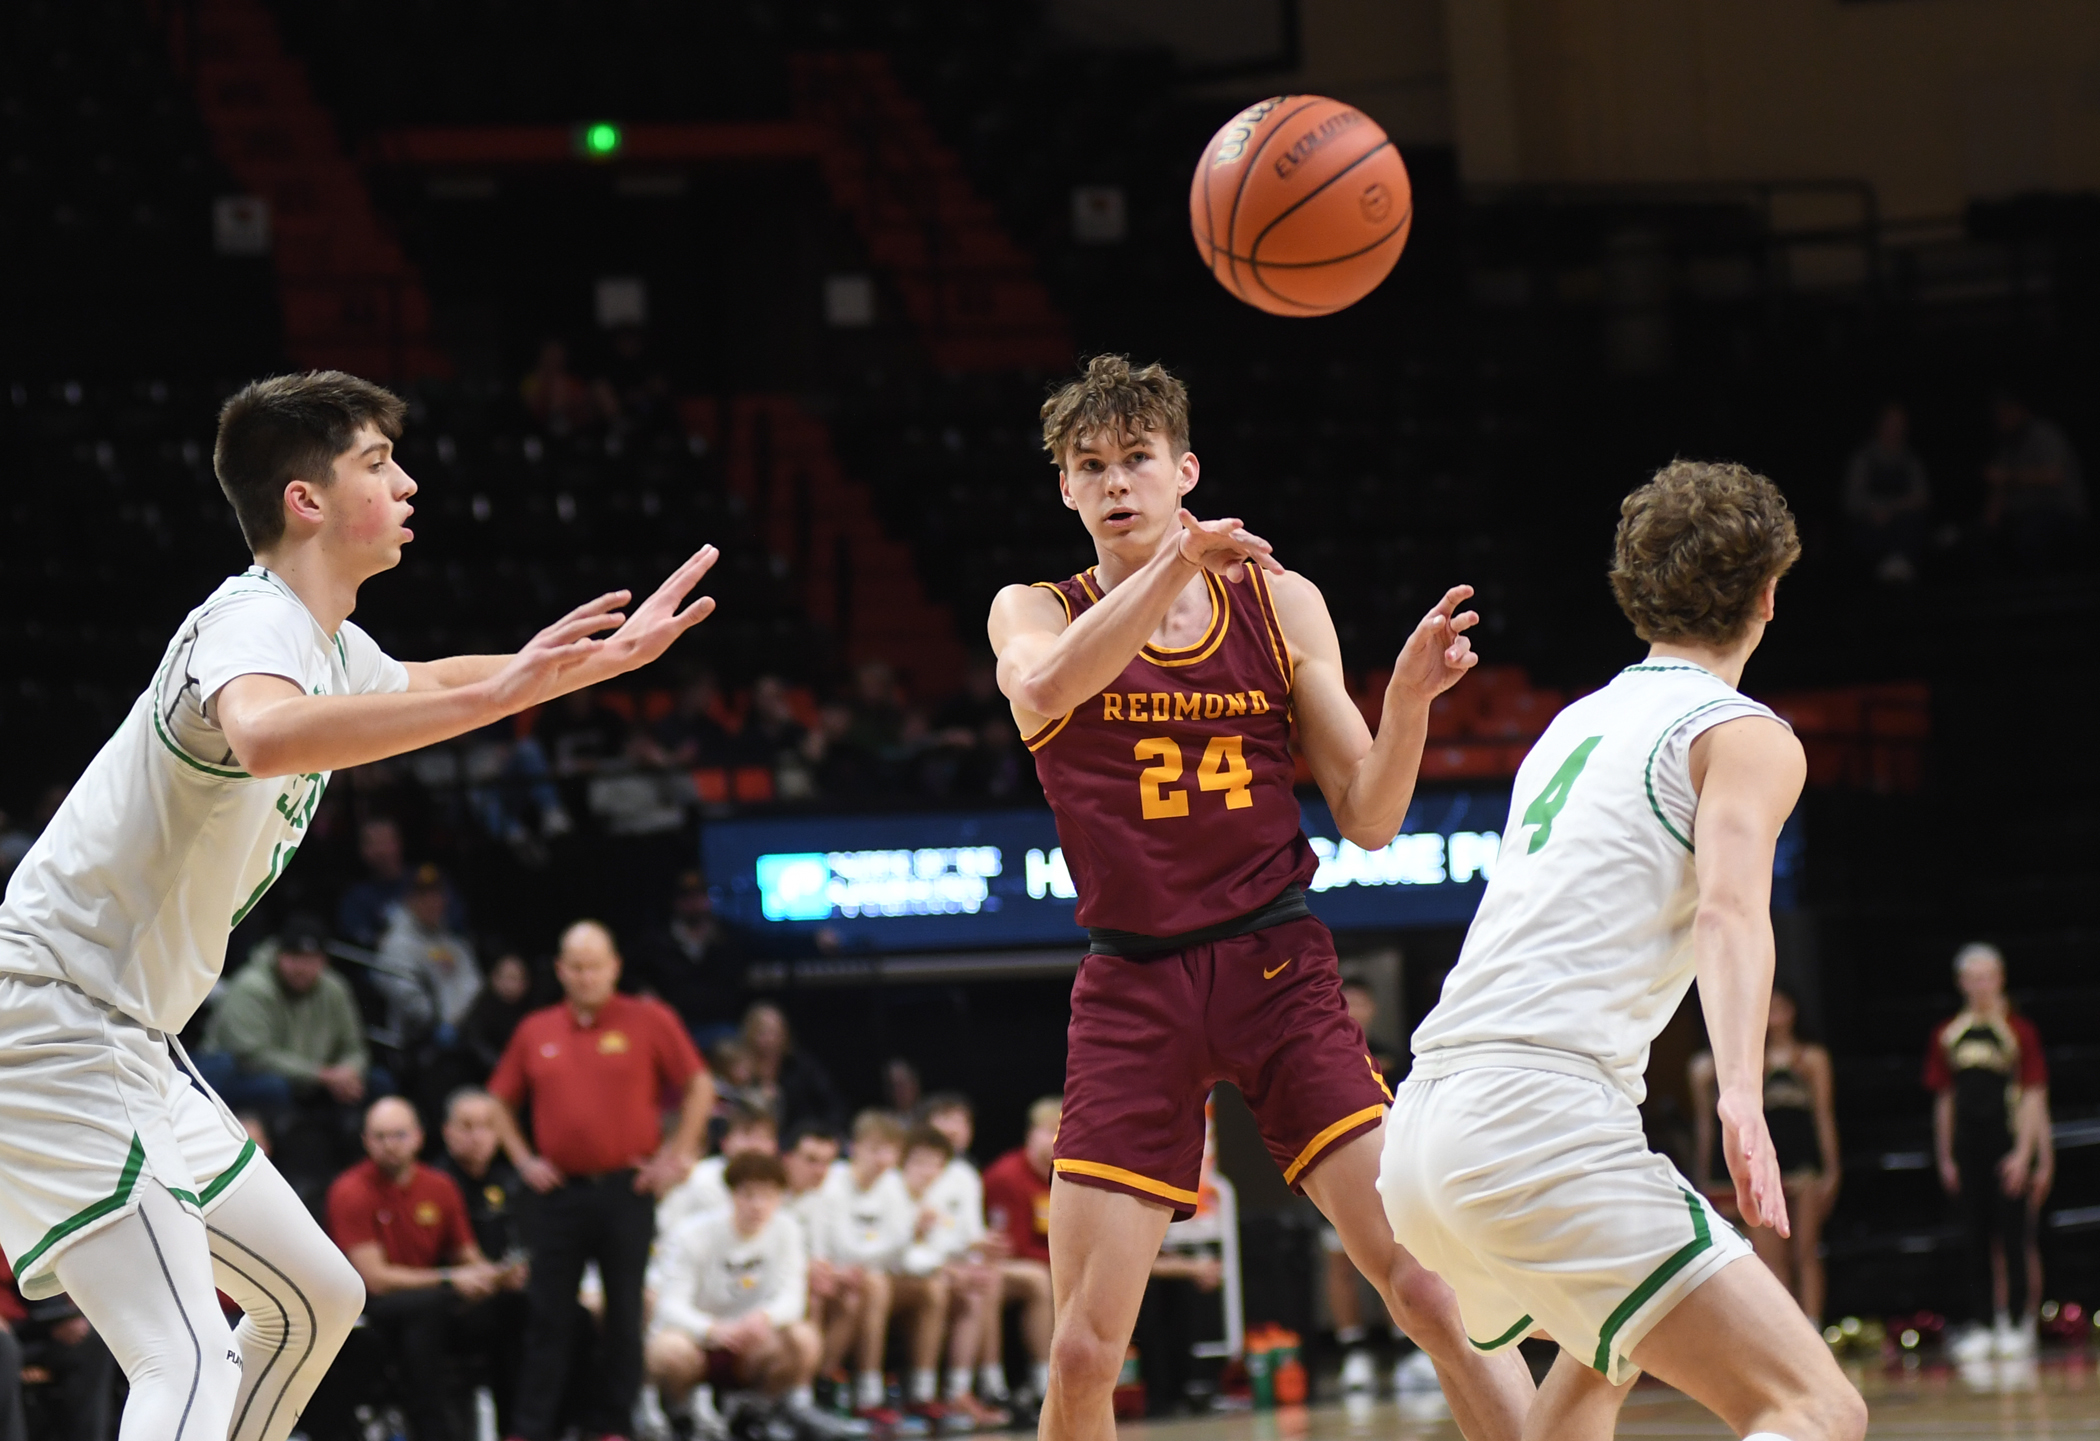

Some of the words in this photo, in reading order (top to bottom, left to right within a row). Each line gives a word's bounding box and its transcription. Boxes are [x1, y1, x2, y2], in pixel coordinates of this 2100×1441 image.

[1102, 690, 1270, 722] REDMOND
[1133, 735, 1253, 820] 24
[1521, 735, 1604, 855] 4
